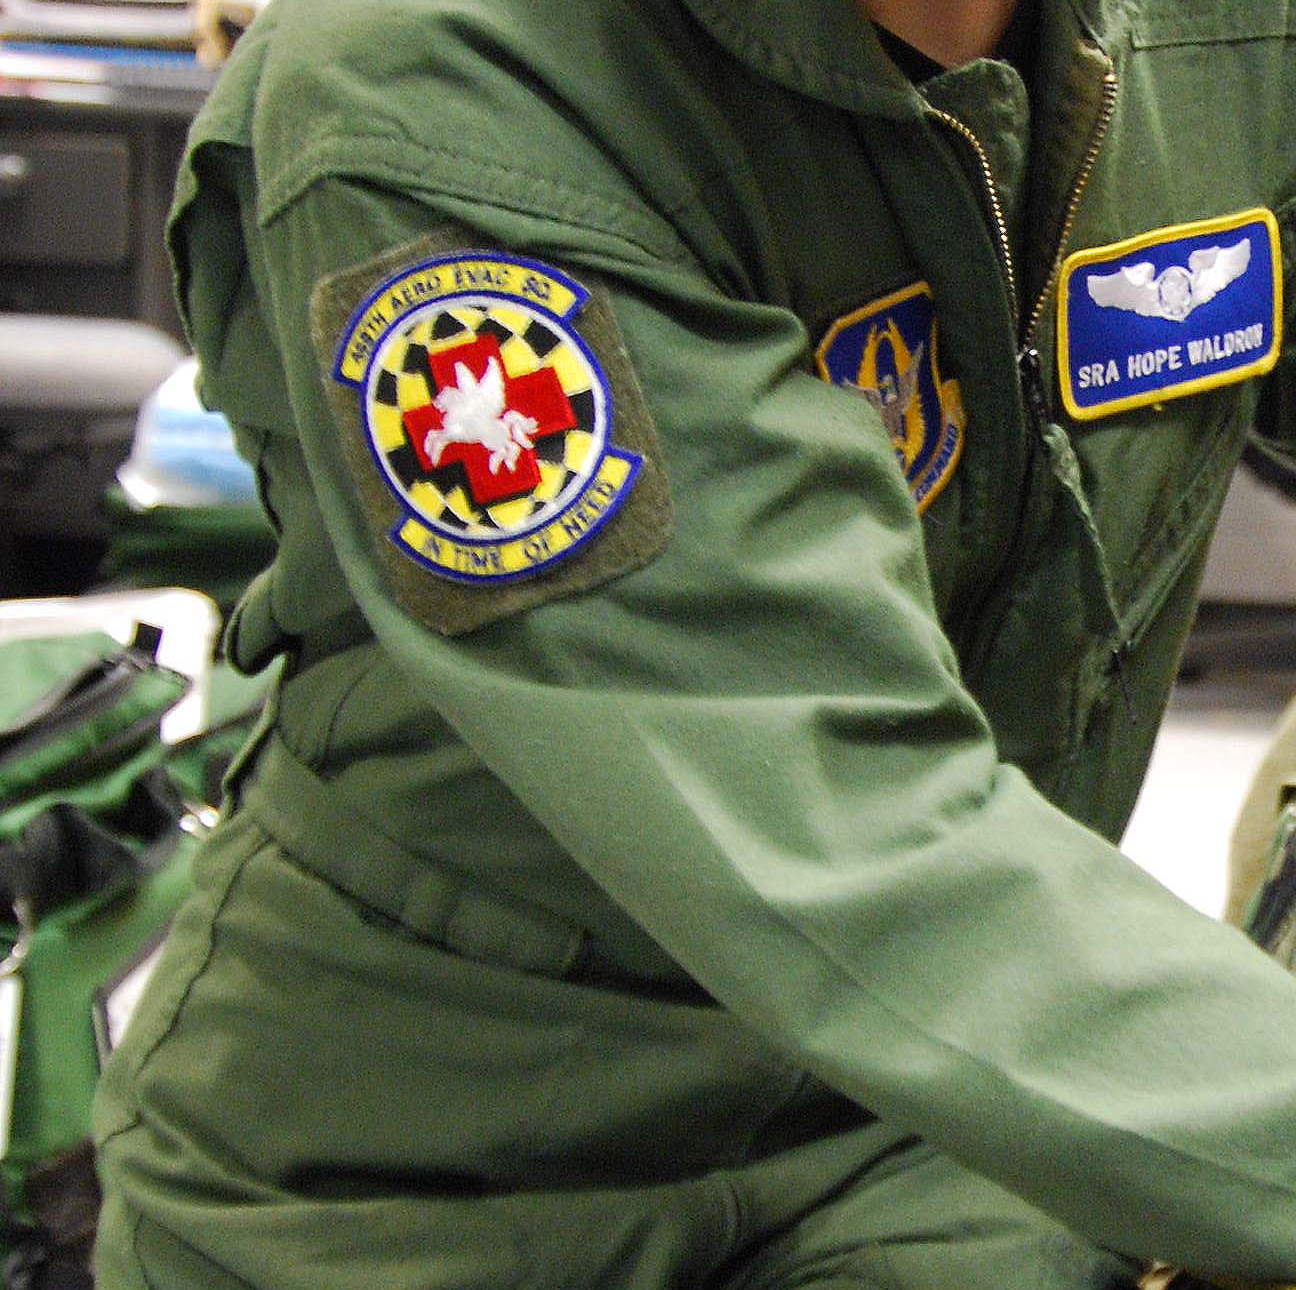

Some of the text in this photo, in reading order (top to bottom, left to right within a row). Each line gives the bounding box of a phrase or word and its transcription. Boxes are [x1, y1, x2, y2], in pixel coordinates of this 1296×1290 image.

[391, 275, 441, 310] AERO
[454, 267, 511, 288] EVAC
[521, 275, 553, 301] SQ
[1077, 323, 1263, 390] SRA HOPE WALDRON
[452, 545, 506, 573] TIME
[522, 528, 555, 564] OF
[559, 477, 617, 543] NEED
